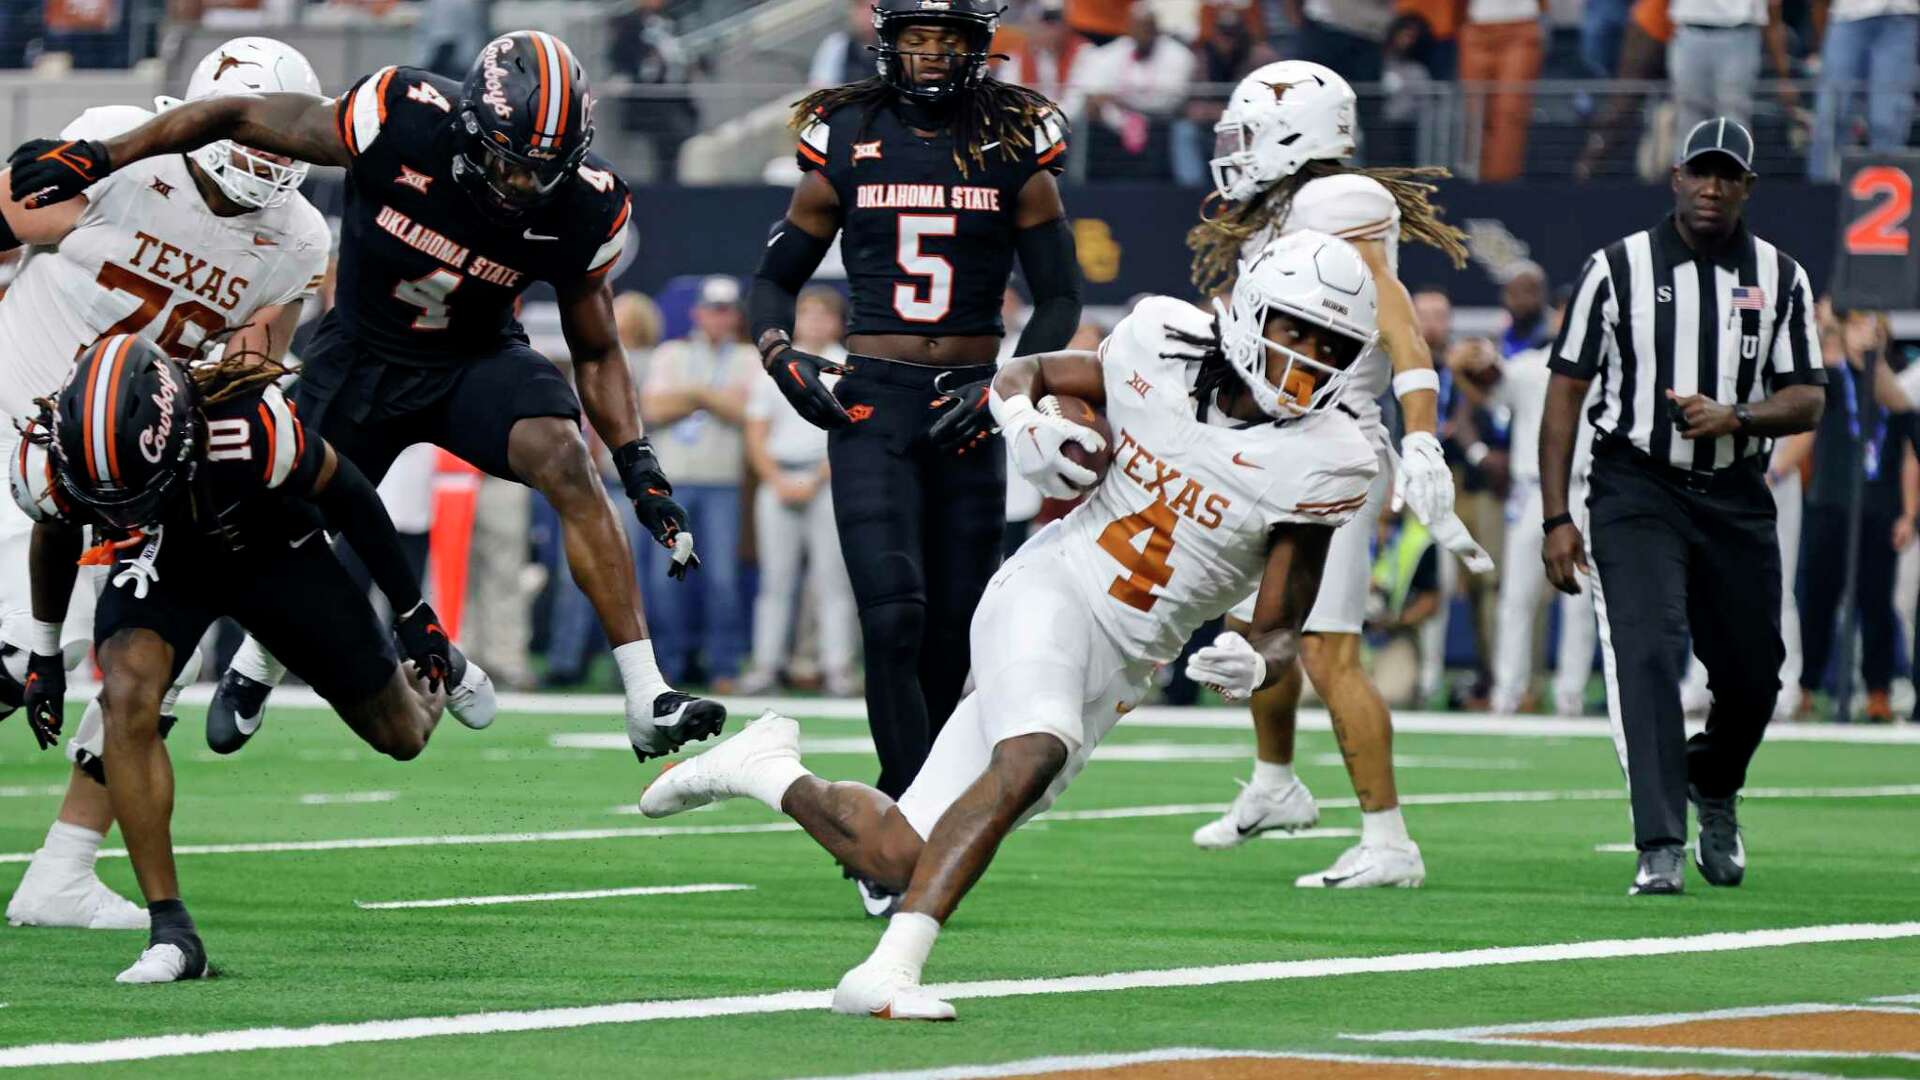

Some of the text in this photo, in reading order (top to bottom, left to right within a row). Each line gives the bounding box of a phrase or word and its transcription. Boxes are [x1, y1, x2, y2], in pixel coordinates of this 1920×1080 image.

[406, 81, 451, 113] 4
[482, 36, 515, 119] Cowboys
[149, 176, 175, 198] XII
[394, 164, 435, 195] XII
[576, 166, 615, 193] 4
[857, 184, 1000, 211] OKLAHOMA STATE
[1845, 166, 1913, 255] 2
[129, 230, 249, 311] TEXAS
[375, 205, 524, 287] OKLAHOMA STATE
[893, 213, 957, 323] 5
[394, 266, 464, 330] 4
[1656, 285, 1673, 303] S
[1742, 335, 1758, 359] U
[139, 358, 179, 464] Cowboys
[1126, 370, 1153, 399] XII
[207, 418, 252, 462] 10
[1112, 427, 1231, 530] TEXAS
[1096, 498, 1179, 613] 4
